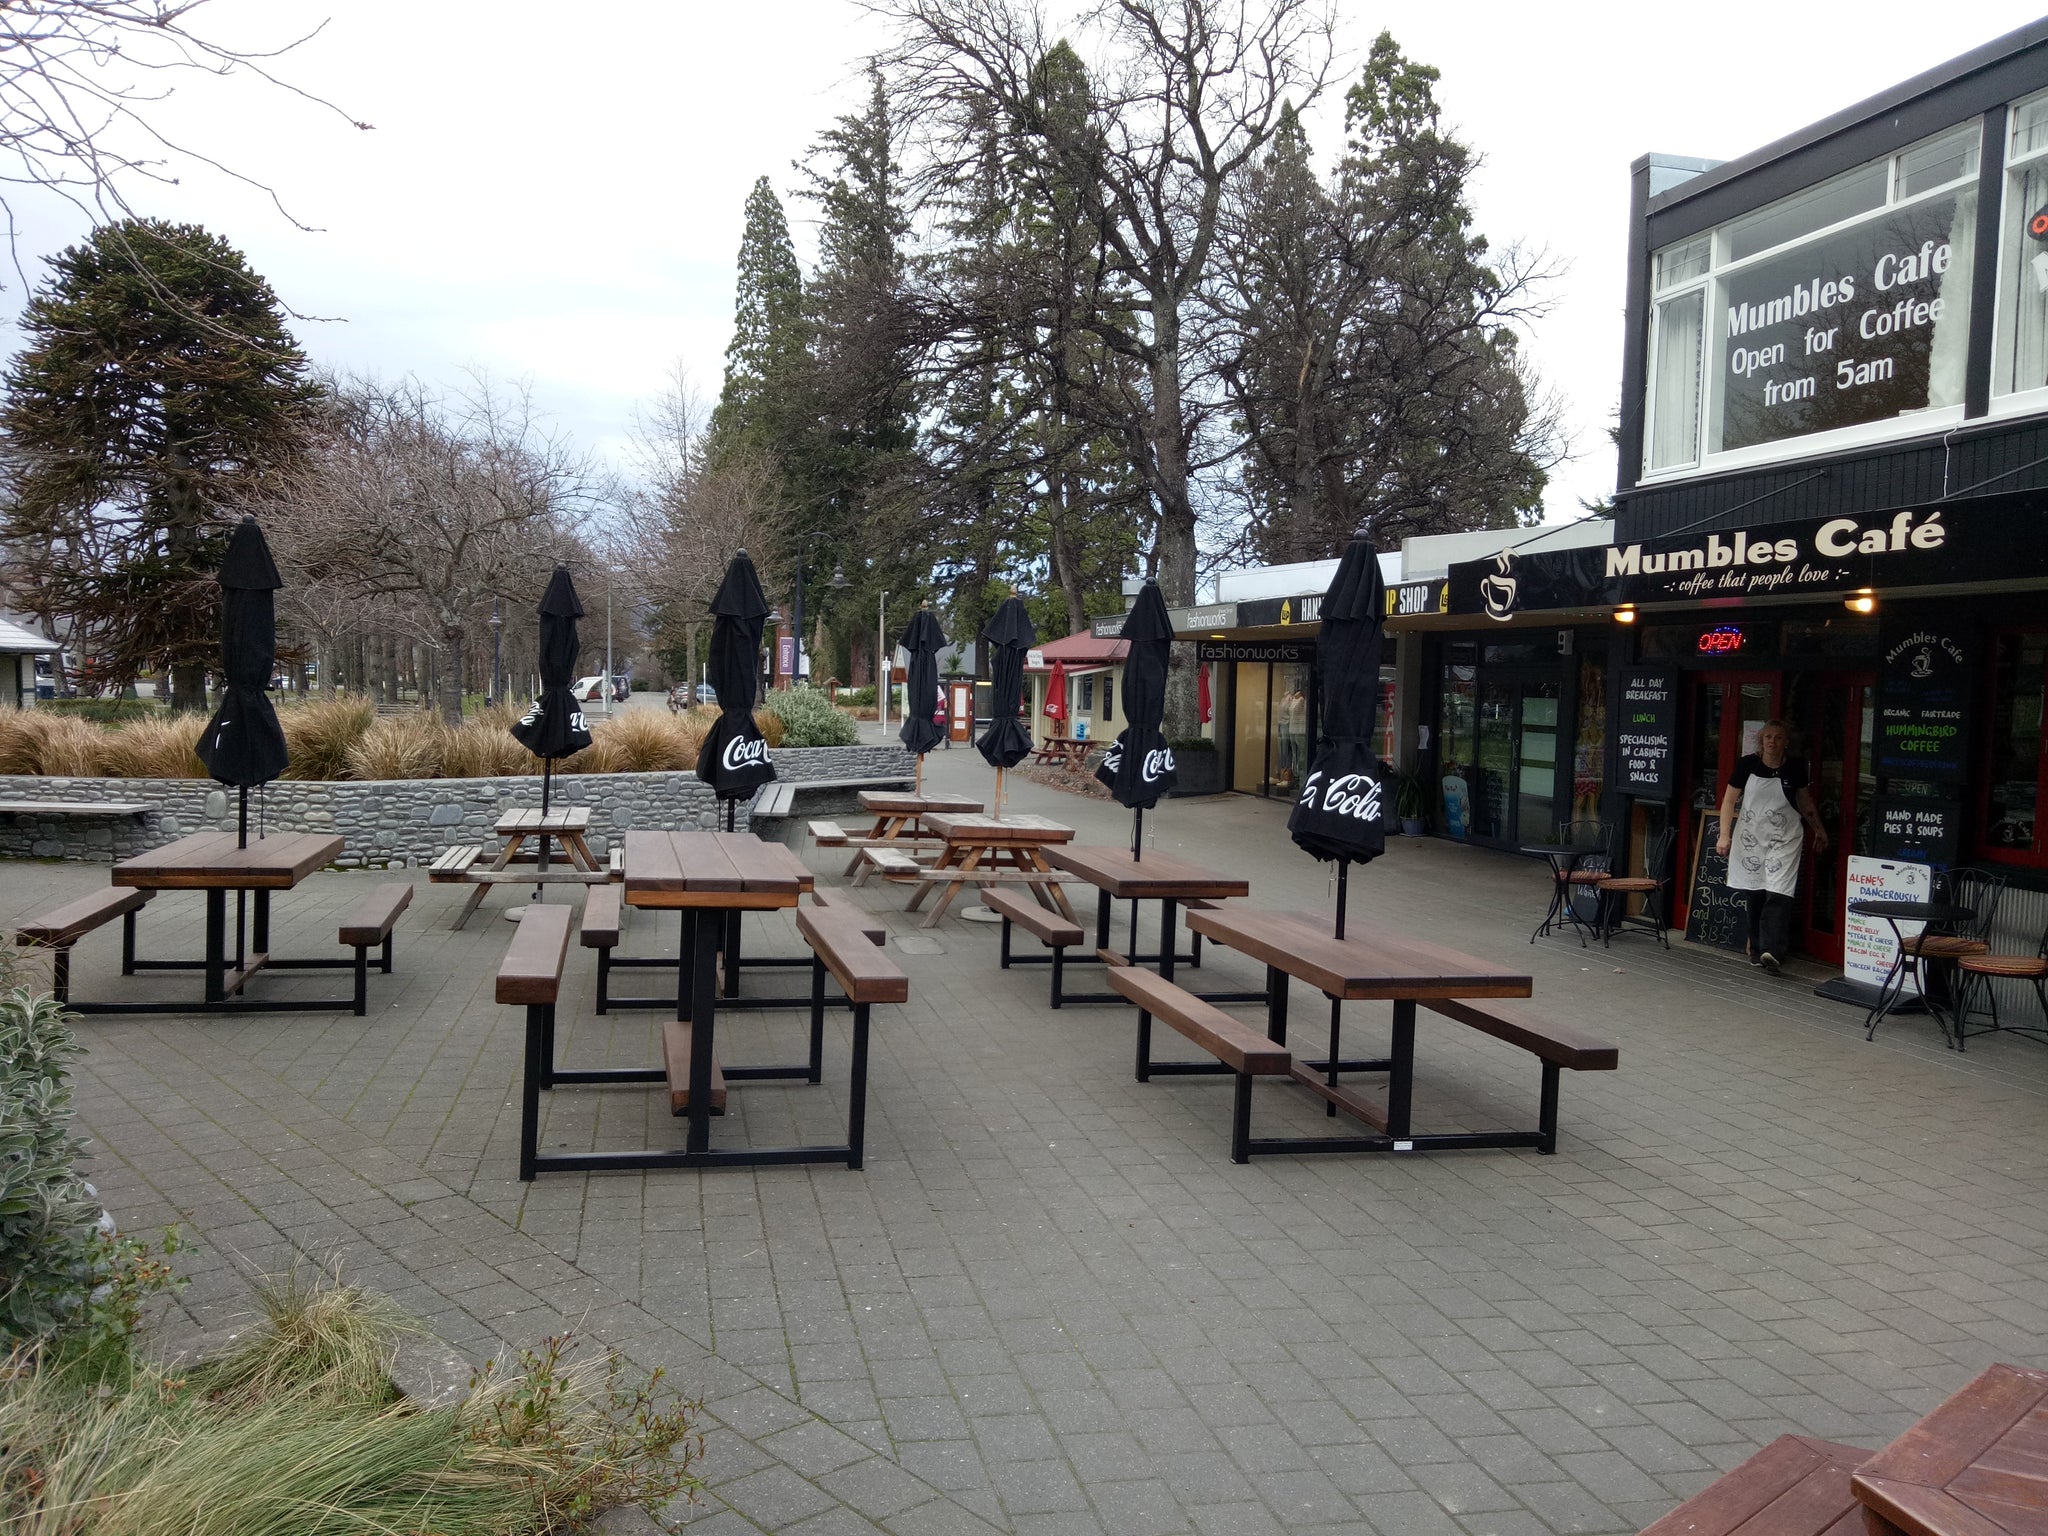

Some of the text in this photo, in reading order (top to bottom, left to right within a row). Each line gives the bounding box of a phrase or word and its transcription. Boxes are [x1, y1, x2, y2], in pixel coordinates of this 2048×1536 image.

[1727, 240, 1952, 338] Mumbles Cafe
[1731, 297, 1946, 378] Open for Coffee
[1763, 357, 1893, 407] from 5am
[1605, 511, 1946, 578] Mumbles Café
[1678, 571, 1715, 596] coffee
[1718, 569, 1747, 588] that
[1747, 565, 1794, 592] people
[1798, 563, 1830, 583] love
[1399, 585, 1428, 614] SHOP
[1187, 611, 1226, 629] fashionworks
[1699, 633, 1742, 650] OPEN
[1885, 631, 1965, 665] Mumbles Cafe
[1200, 643, 1299, 659] fashionworks
[1630, 677, 1664, 689] ALL DAY
[1625, 690, 1668, 702] BREAKFAST
[1632, 712, 1656, 724] LUNCH
[1921, 709, 1961, 720] FAIRTRADE
[1386, 692, 1395, 765] SAL
[1885, 723, 1957, 738] HUMMINGBIRD
[1619, 734, 1668, 746] SPECIALISING
[1899, 740, 1941, 753] COFFEE
[1622, 745, 1668, 759] IN CABINET
[1628, 758, 1656, 770] FOOD &
[1629, 770, 1659, 783] SNACKS
[1322, 773, 1382, 822] Cola
[1885, 809, 1944, 825] HAND MADE
[1883, 822, 1944, 838] PIES & SOUPS
[1848, 873, 1885, 887] ALENE'S
[1696, 886, 1729, 907] Blue
[1859, 886, 1919, 903] DANGEROUSLY
[1692, 906, 1710, 921] and
[1850, 932, 1867, 941] STEAK
[1875, 937, 1893, 946] CHEESE
[1850, 947, 1868, 955] BACON
[1869, 950, 1880, 958] EGG
[1873, 944, 1892, 953] CHEESE
[1849, 961, 1871, 971] CHICKEN
